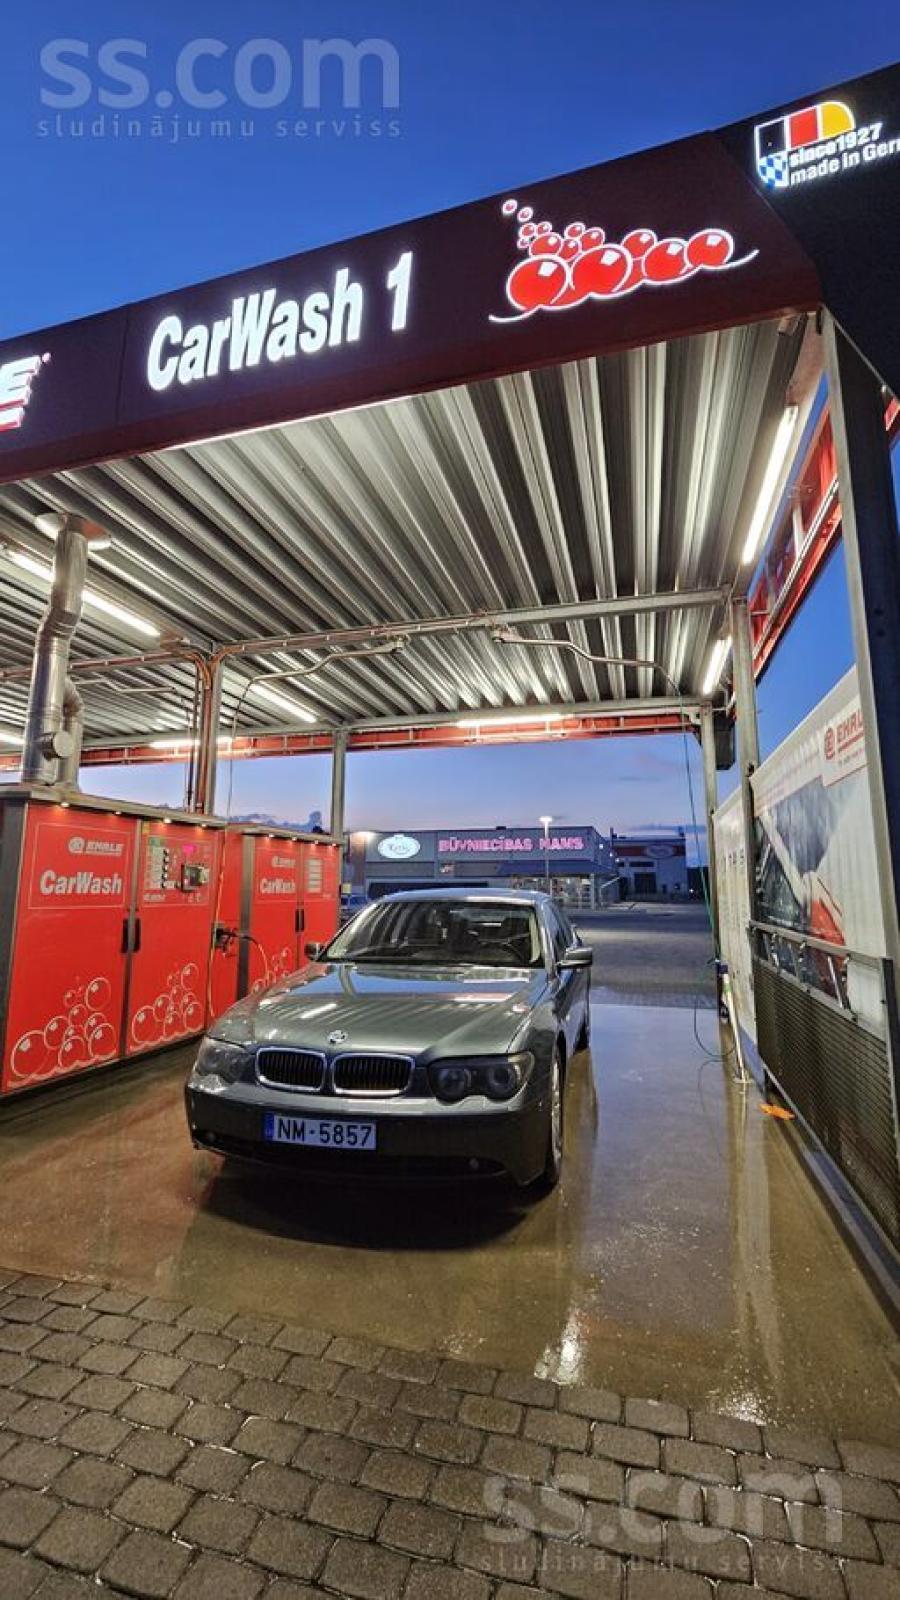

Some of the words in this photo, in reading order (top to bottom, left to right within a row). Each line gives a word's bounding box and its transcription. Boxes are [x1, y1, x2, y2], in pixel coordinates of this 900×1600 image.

[790, 159, 840, 186] made
[841, 151, 860, 171] in
[862, 138, 900, 162] Ger
[146, 268, 364, 391] CarWash
[386, 252, 413, 331] 1
[39, 870, 123, 895] CarWash
[277, 1117, 372, 1147] NM-5857
